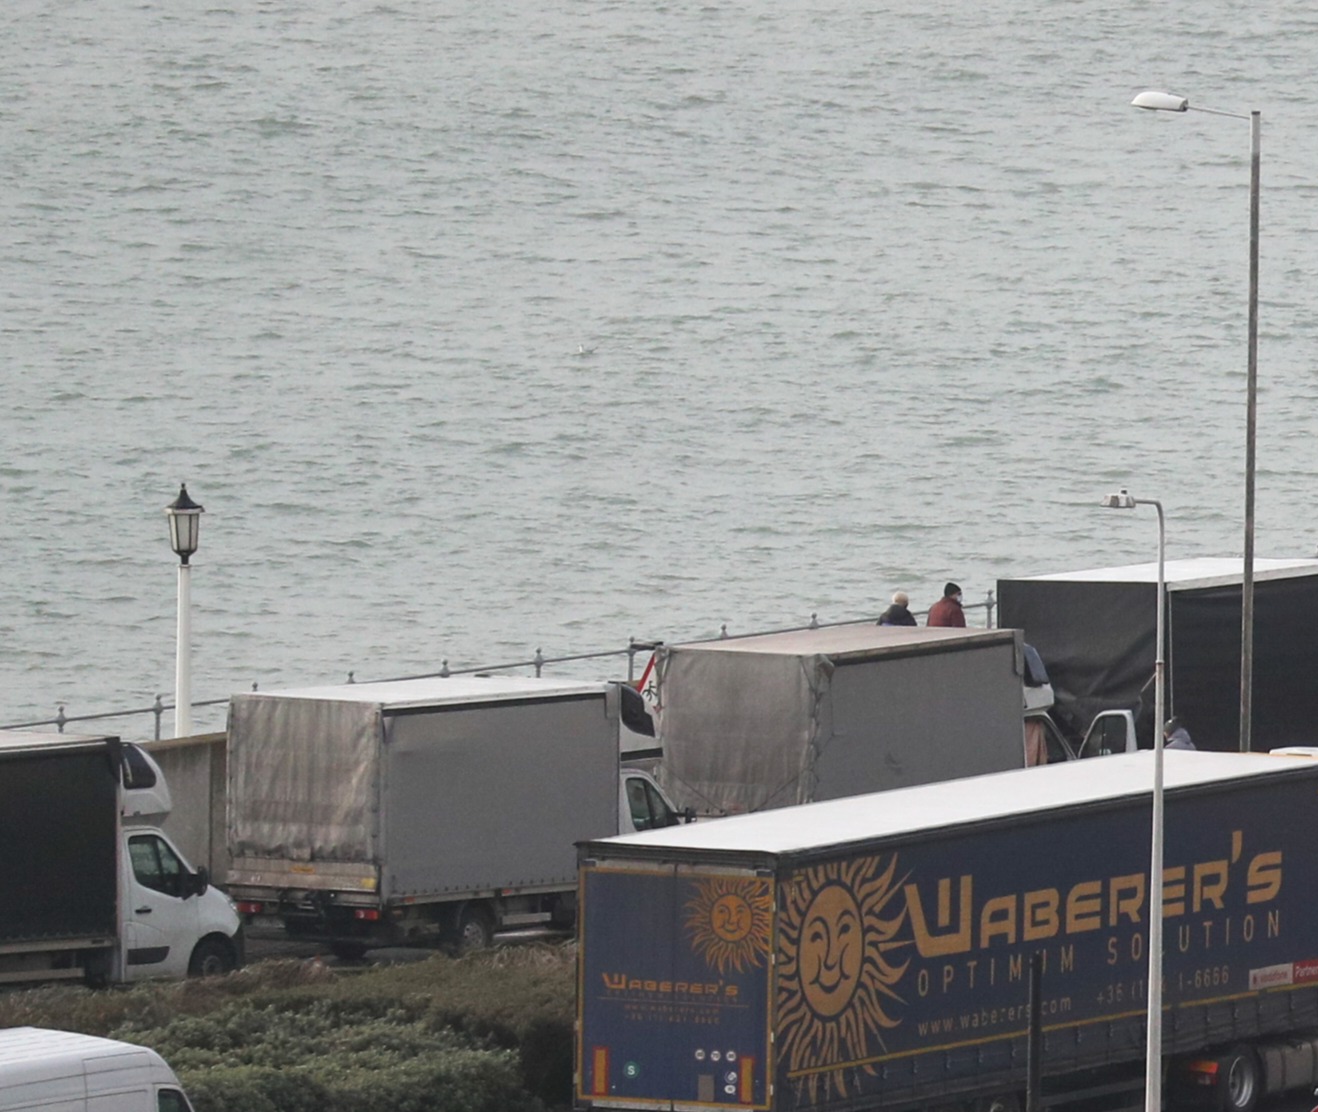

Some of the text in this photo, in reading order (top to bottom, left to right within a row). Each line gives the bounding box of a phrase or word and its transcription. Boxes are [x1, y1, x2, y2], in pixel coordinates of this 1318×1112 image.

[1108, 910, 1280, 965] SOUTION
[917, 996, 1072, 1037] www.wabererscom
[627, 1065, 636, 1076] S
